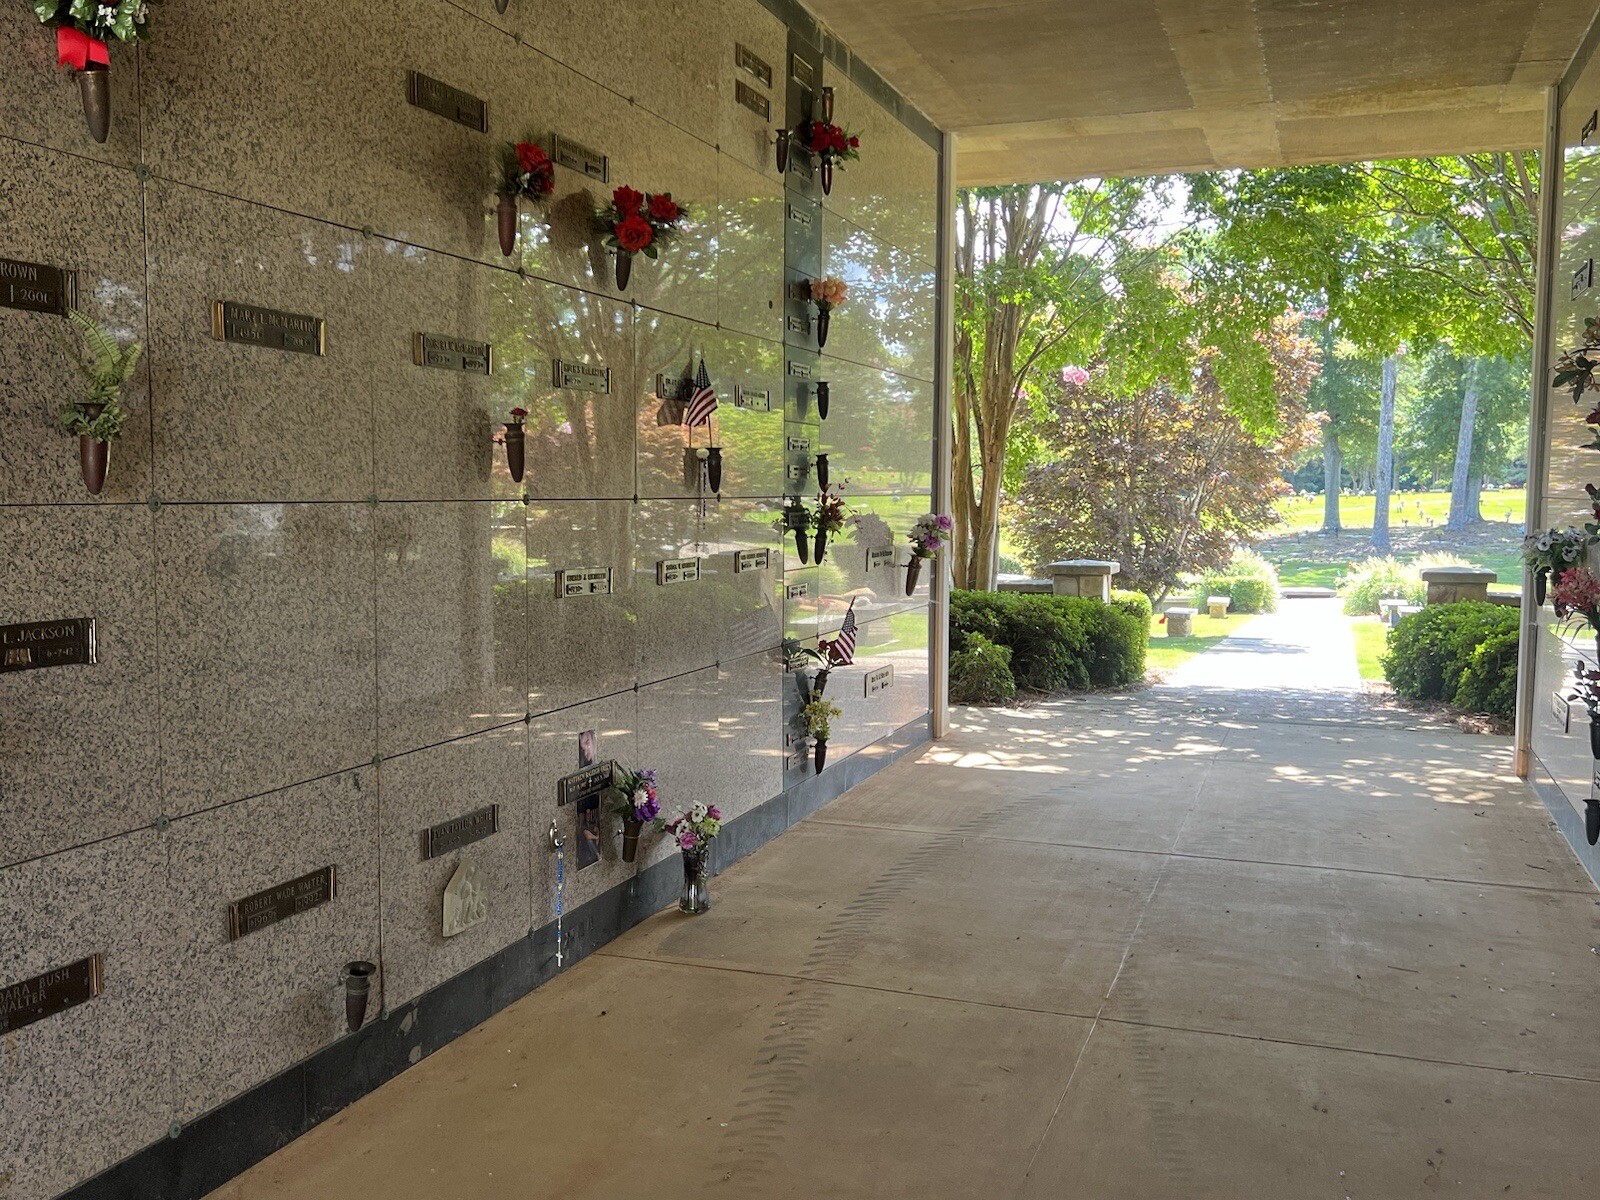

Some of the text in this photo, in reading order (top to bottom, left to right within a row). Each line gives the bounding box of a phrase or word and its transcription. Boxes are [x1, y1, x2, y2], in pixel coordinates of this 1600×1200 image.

[17, 625, 75, 643] JACKSON
[244, 895, 272, 915] ROBERT
[39, 968, 70, 989] BUSH
[0, 989, 47, 1016] WALTER
